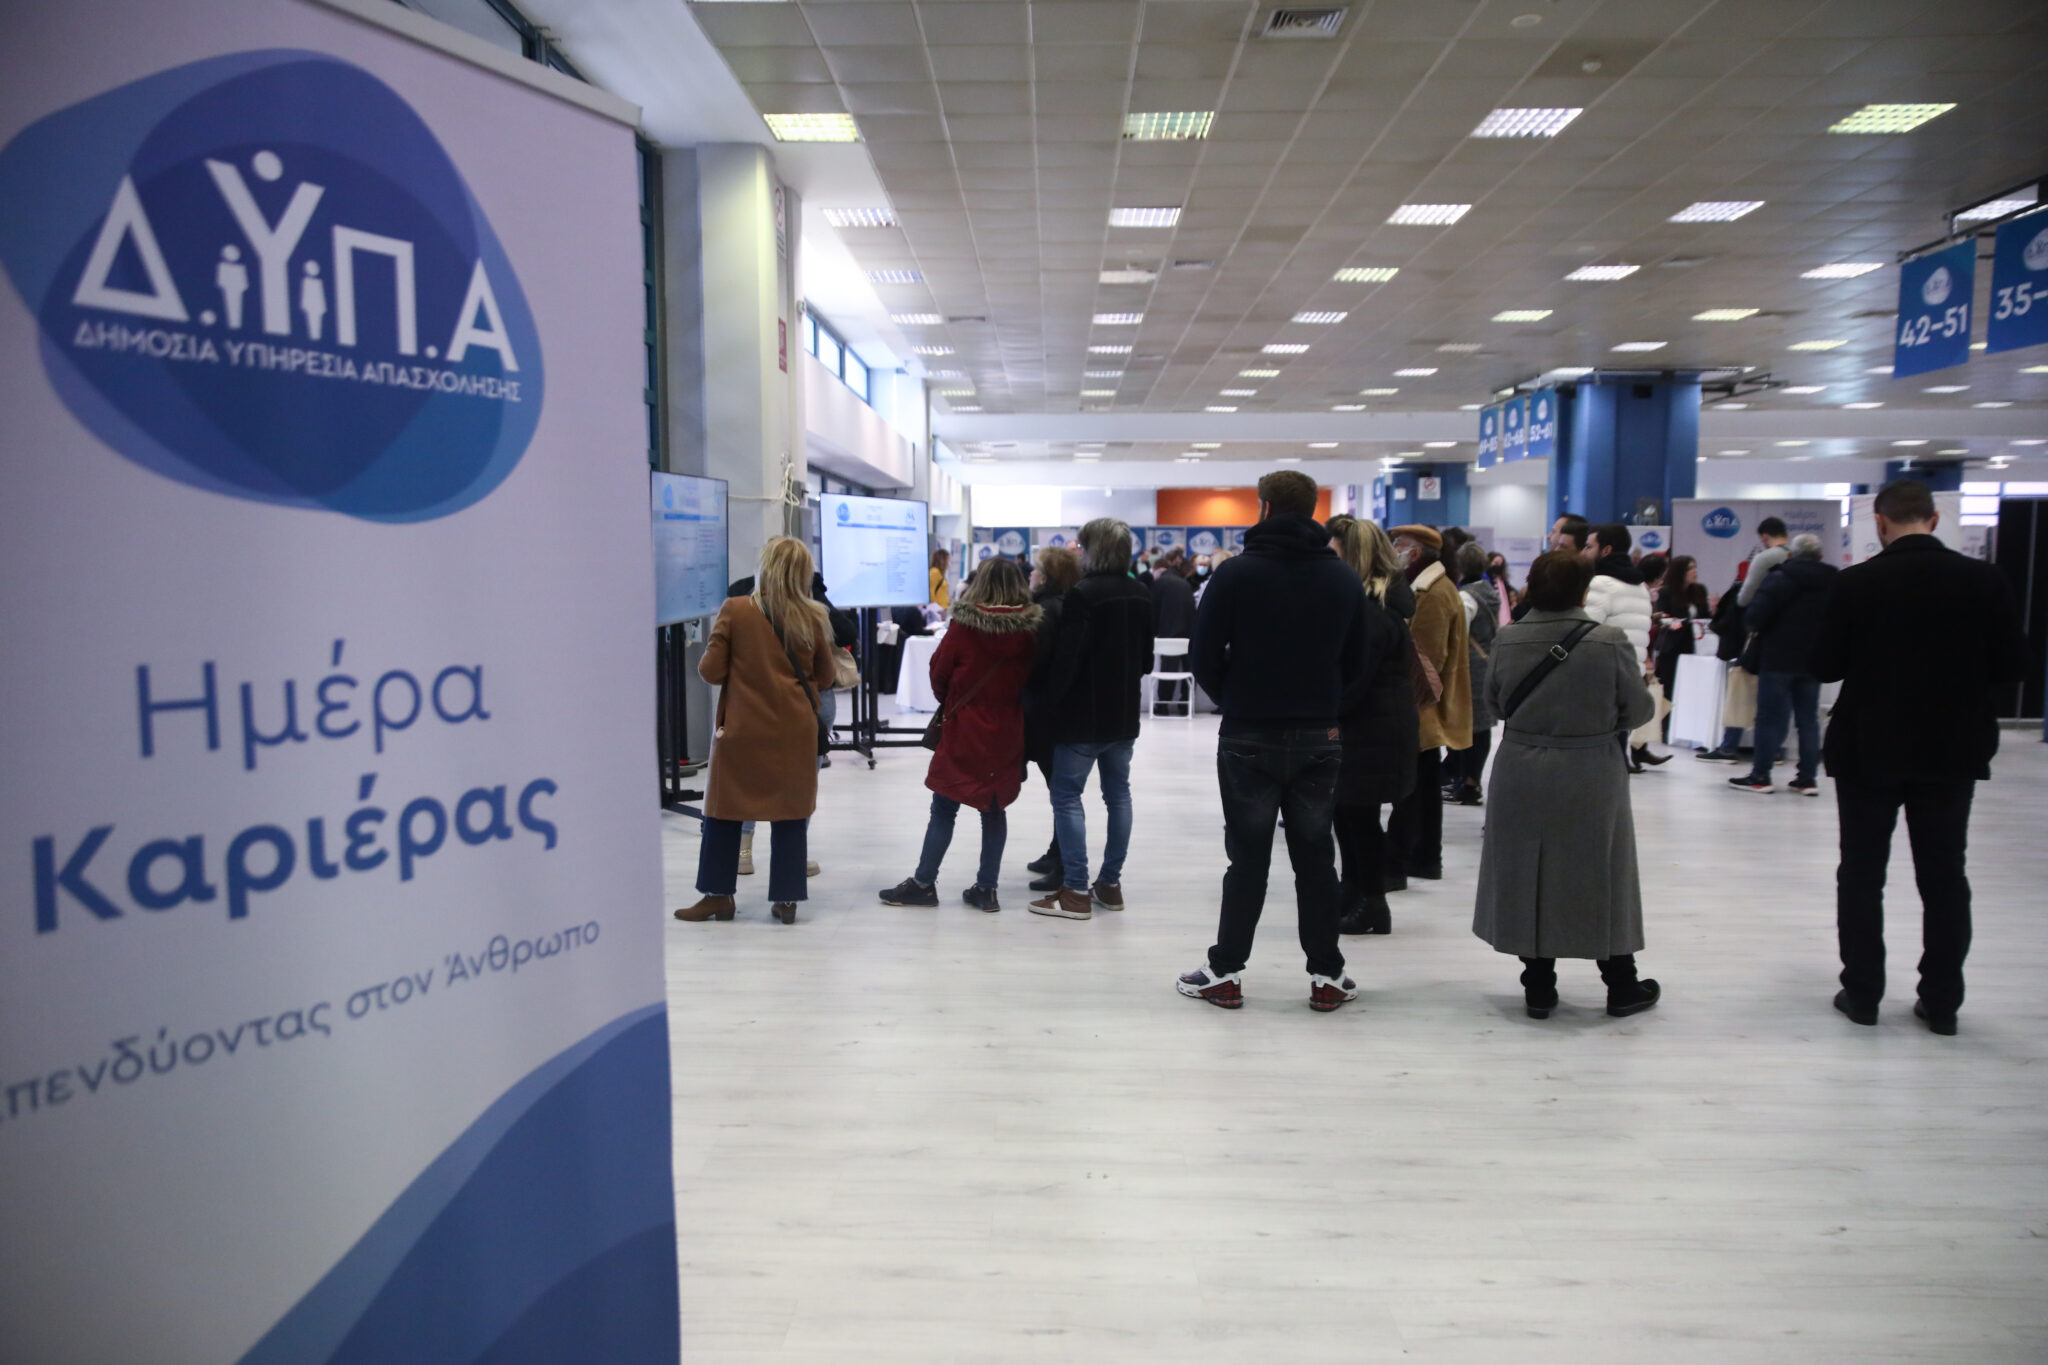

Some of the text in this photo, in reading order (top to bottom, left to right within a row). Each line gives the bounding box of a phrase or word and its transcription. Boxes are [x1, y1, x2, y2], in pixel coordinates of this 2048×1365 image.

[1899, 303, 1968, 347] 42-51
[1995, 282, 2048, 320] 35-
[74, 321, 521, 402] ΔΗΜΟΣΙΑ ΥΠΗΡΕΣΙΑ ΑΠΑΣΧΟΛΗΣΗΣ
[136, 639, 490, 771] Ημέρα
[30, 774, 556, 937] Καριέρας
[0, 920, 601, 1120] πενδύοντας στον Άνθρωπο
